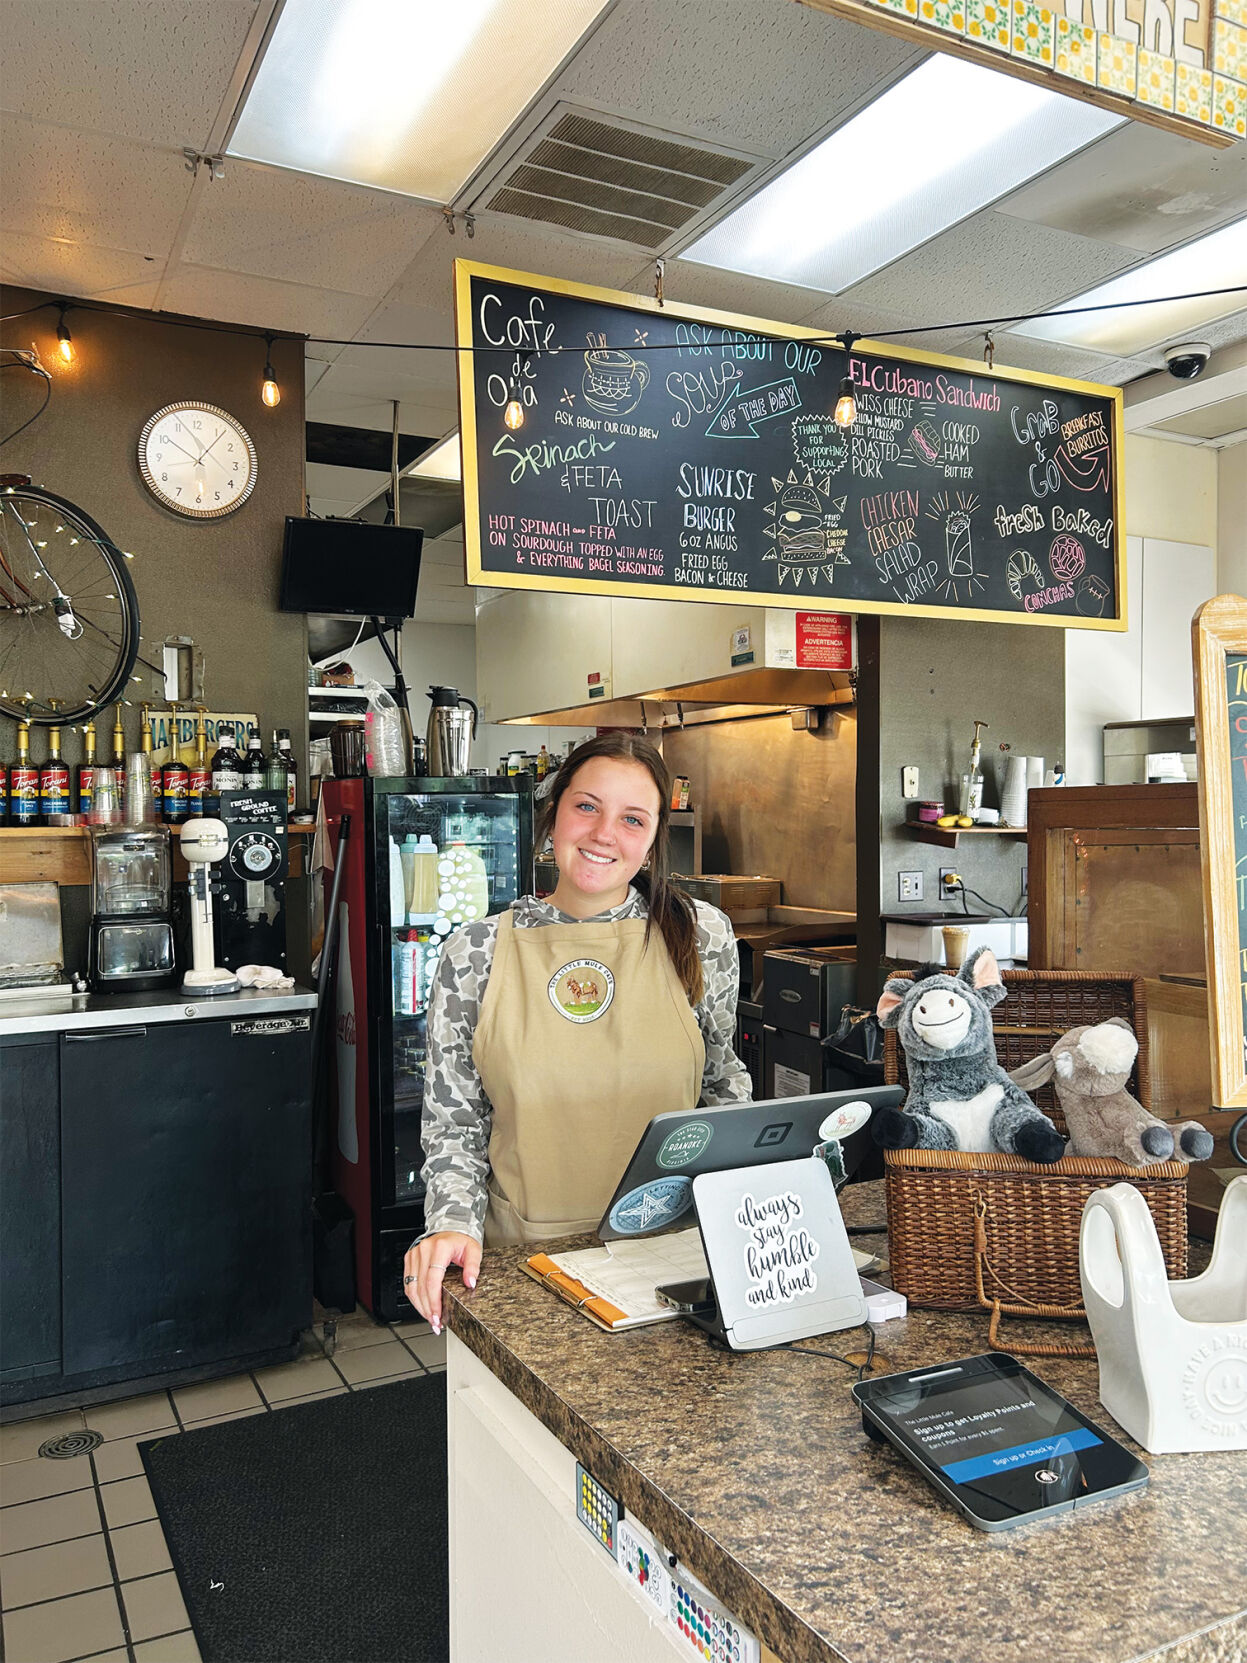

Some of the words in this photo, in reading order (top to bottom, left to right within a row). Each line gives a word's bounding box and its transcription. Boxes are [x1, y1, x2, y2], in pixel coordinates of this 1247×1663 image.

[481, 294, 562, 358] Cafe
[676, 324, 713, 357] ASK
[722, 329, 772, 361] ABOUT
[784, 342, 822, 376] OUR
[512, 352, 537, 378] de
[936, 374, 1000, 412] Sandwich
[720, 409, 737, 430] OF
[738, 398, 768, 420] THE
[768, 384, 796, 412] DAY
[851, 393, 882, 414] WISS
[884, 398, 914, 418] CHEESE
[175, 423, 182, 432] 11
[193, 420, 202, 430] 12
[555, 410, 574, 426] ASK
[576, 416, 602, 430] ABOUT
[604, 421, 618, 433] OUR
[620, 424, 637, 436] COLD
[639, 427, 659, 440] BREW
[797, 425, 821, 435] THANK
[823, 424, 837, 435] YOU
[851, 424, 864, 436] DILL
[868, 428, 894, 442] PICKLES
[874, 415, 904, 431] MUSTARD
[942, 420, 980, 445] COOKED
[159, 434, 170, 444] 10
[809, 436, 824, 444] FOR
[852, 438, 900, 462] ROASTED
[1067, 426, 1109, 458] BURRITOS
[492, 433, 616, 484] Spinach
[813, 459, 836, 468] LOCAL
[944, 445, 970, 462] HAM
[1034, 441, 1047, 462] &
[571, 466, 622, 490] FETA
[852, 456, 884, 480] PORK
[944, 466, 974, 478] BUTTER
[1028, 458, 1060, 498] GO
[675, 462, 757, 500] SUNRISE
[588, 497, 658, 528] TOAST
[684, 503, 736, 532] BURGER
[860, 490, 920, 530] CHICKEN
[488, 514, 515, 530] HOT
[520, 518, 570, 536] SPINACH
[590, 525, 616, 540] FETA
[868, 518, 918, 556] CAESAR
[490, 532, 506, 547] ON
[512, 534, 574, 552] SOURDOUGH
[578, 542, 612, 557] TOPPED
[614, 546, 636, 558] WITH
[636, 548, 648, 560] AN
[649, 548, 664, 562] EGG
[705, 534, 738, 552] ANGUS
[516, 551, 526, 564] &
[530, 552, 584, 570] EVERYTHING
[588, 558, 614, 572] BAGEL
[682, 554, 709, 570] FRIED
[711, 555, 728, 570] EGG
[875, 541, 922, 584] SALAD
[674, 568, 704, 584] BACON
[708, 574, 716, 582] &
[716, 571, 748, 588] CHEESE
[894, 560, 938, 605] WRAP
[1024, 581, 1075, 614] CONCHAS
[812, 616, 837, 624] WARNING
[804, 638, 843, 646] ADVERTENCIA
[42, 775, 68, 791] Torani
[166, 776, 188, 790] Tora
[230, 798, 252, 808] FRESH
[241, 801, 269, 810] GROUND
[252, 806, 278, 814] COFFEE
[550, 978, 558, 988] THE
[558, 962, 581, 977] LITTLE
[585, 961, 602, 970] MULE
[668, 1140, 702, 1151] ROANOKE
[738, 1195, 800, 1227] always
[754, 1224, 785, 1249] stay
[748, 1232, 818, 1278] humble
[748, 1280, 777, 1304] and
[778, 1268, 814, 1298] kind
[914, 1426, 933, 1435] Sign
[954, 1417, 970, 1426] get
[967, 1410, 997, 1422] Loyalty
[995, 1405, 1020, 1415] Points
[1020, 1400, 1036, 1409] and
[922, 1430, 956, 1442] coupons
[992, 1457, 1010, 1466] Sign
[1010, 1454, 1020, 1462] up
[1026, 1446, 1046, 1456] Check
